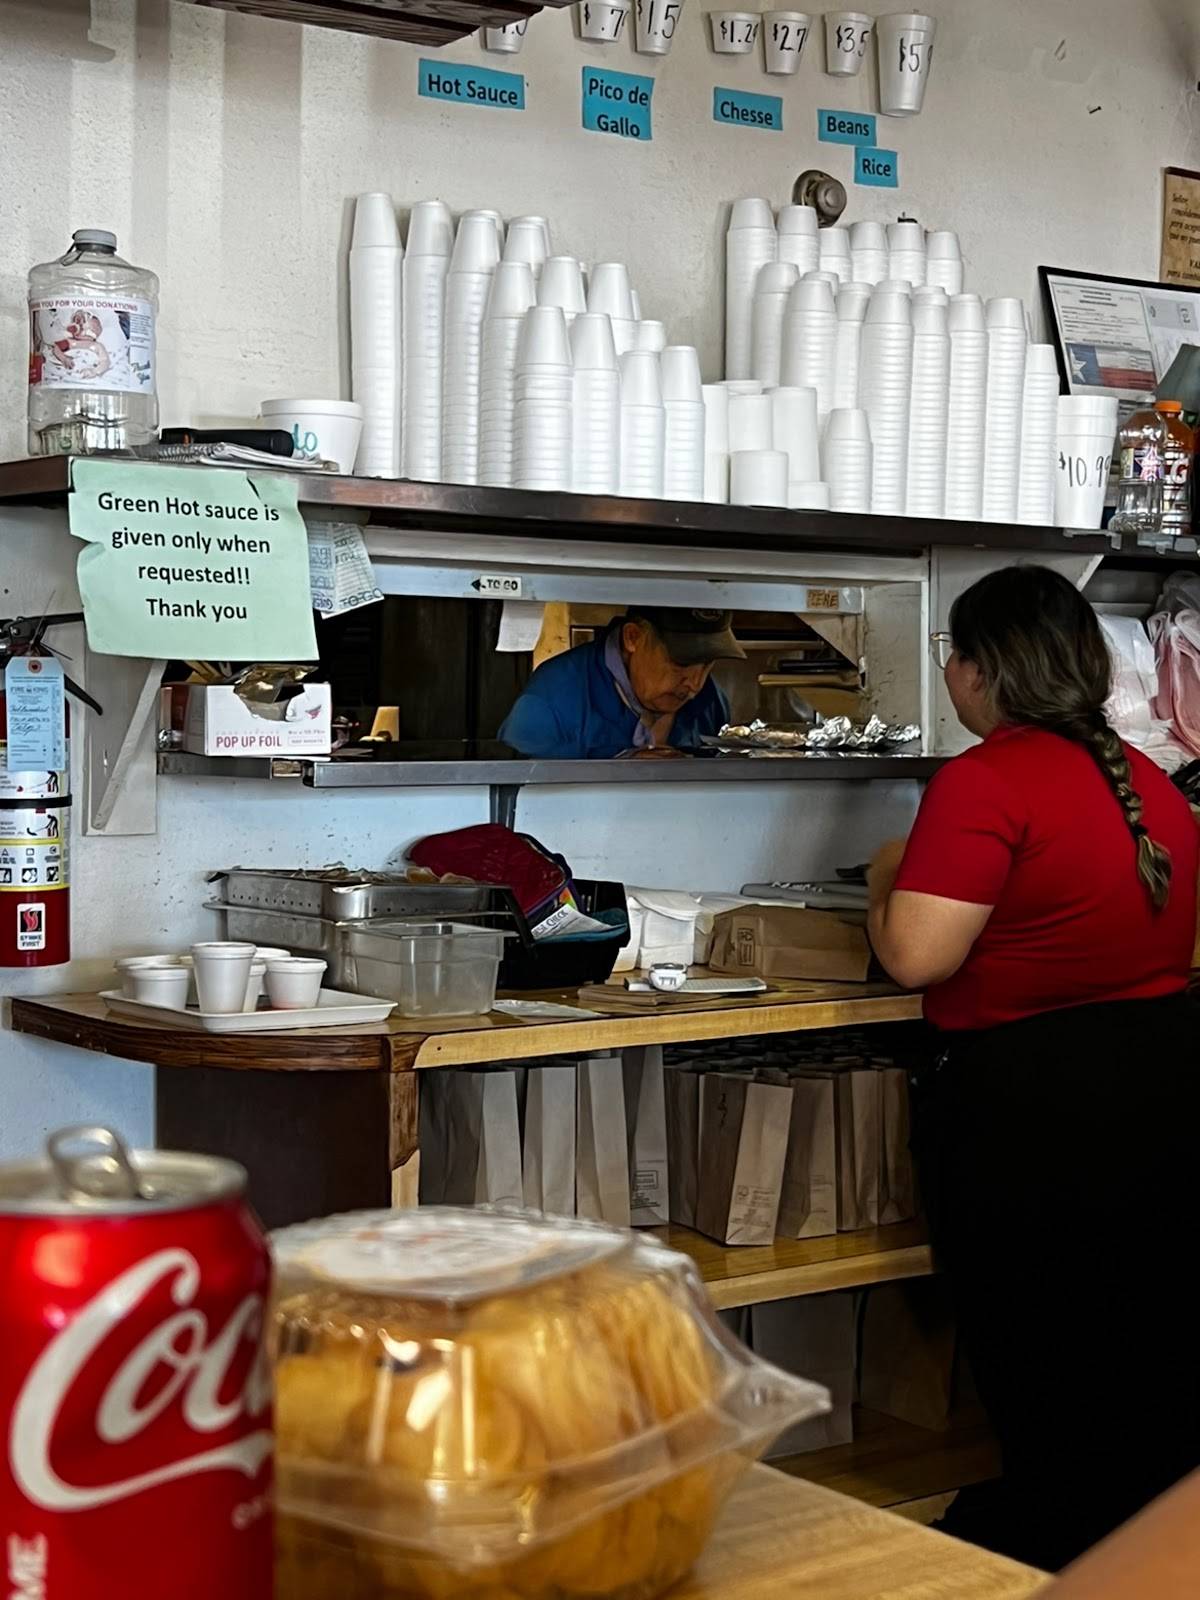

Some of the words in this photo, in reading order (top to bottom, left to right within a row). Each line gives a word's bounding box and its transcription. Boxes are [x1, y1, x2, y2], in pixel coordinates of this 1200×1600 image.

[428, 73, 461, 96] Hot
[466, 79, 518, 106] Sauce
[588, 78, 623, 101] Pico
[628, 86, 649, 106] de
[720, 101, 774, 126] Chesse
[597, 114, 641, 137] Gallo
[826, 116, 870, 137] Beans
[862, 158, 891, 177] Rice
[55, 300, 70, 308] FOR
[72, 300, 94, 308] YOUR
[96, 301, 138, 311] DONATIONS
[98, 492, 159, 513] Green
[166, 497, 200, 516] Hot
[205, 504, 258, 521] sauce
[264, 504, 280, 521] is
[112, 527, 165, 549] given
[172, 531, 212, 554] only
[217, 535, 271, 553] when
[138, 565, 251, 585] requested!!
[146, 598, 207, 618] Thank
[211, 604, 247, 622] you
[216, 736, 239, 748] POP
[241, 736, 256, 748] UP
[258, 735, 282, 748] FOIL
